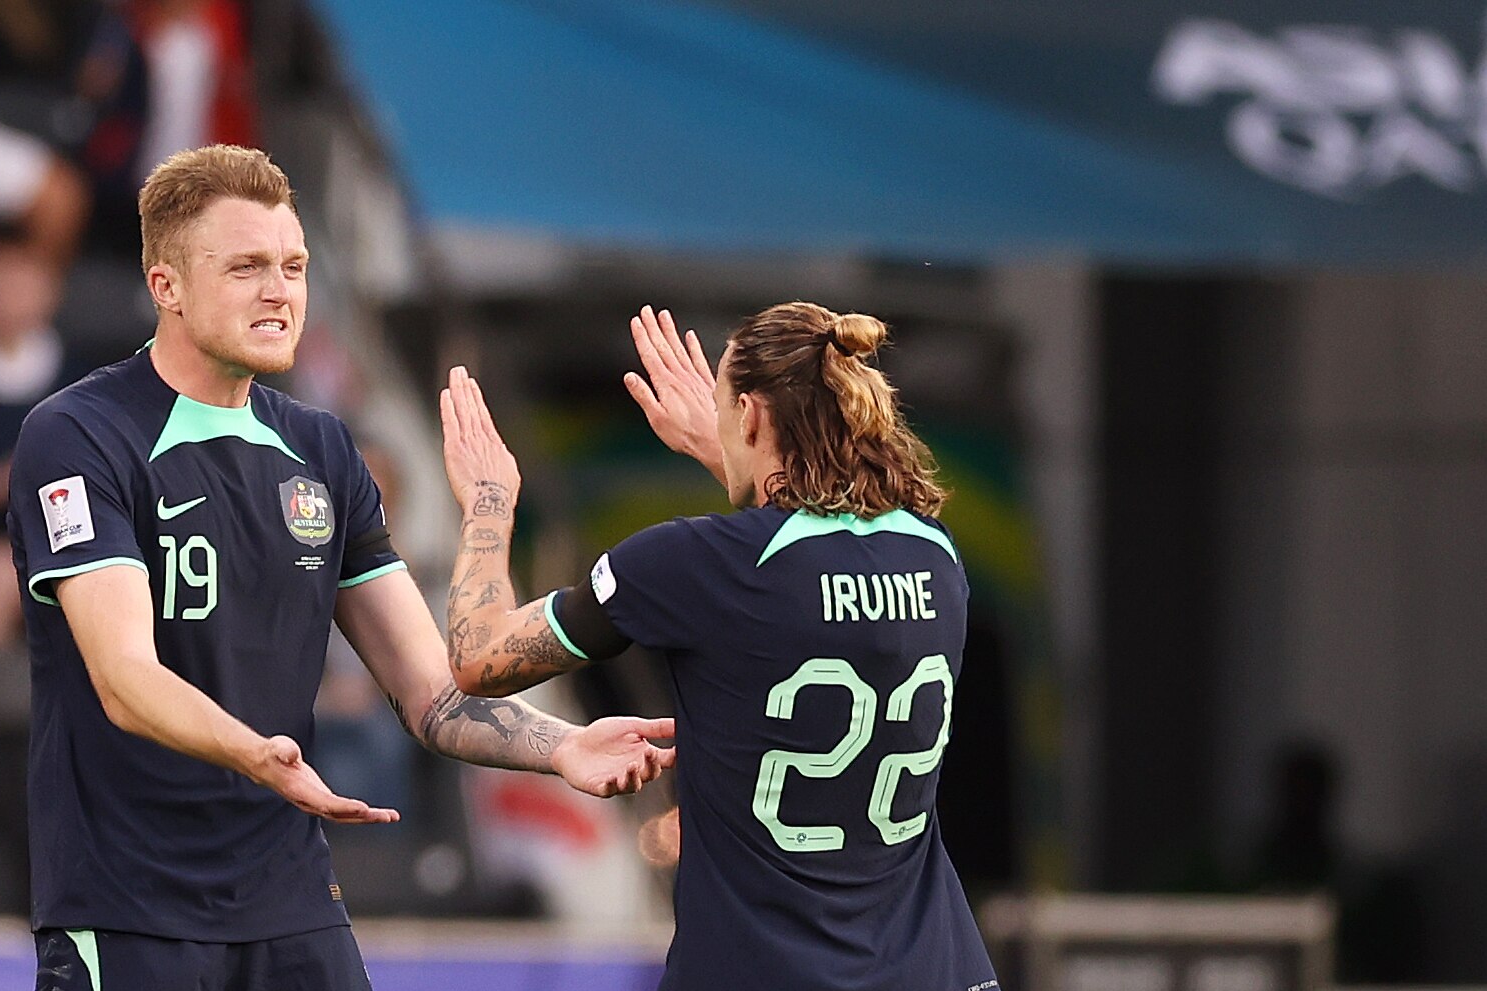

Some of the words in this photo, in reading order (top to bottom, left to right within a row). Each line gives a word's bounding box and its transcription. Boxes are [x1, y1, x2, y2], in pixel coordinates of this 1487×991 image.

[1151, 18, 1487, 125] ASI
[158, 534, 219, 621] 19
[819, 570, 937, 623] IRVINE
[751, 653, 954, 853] 22
